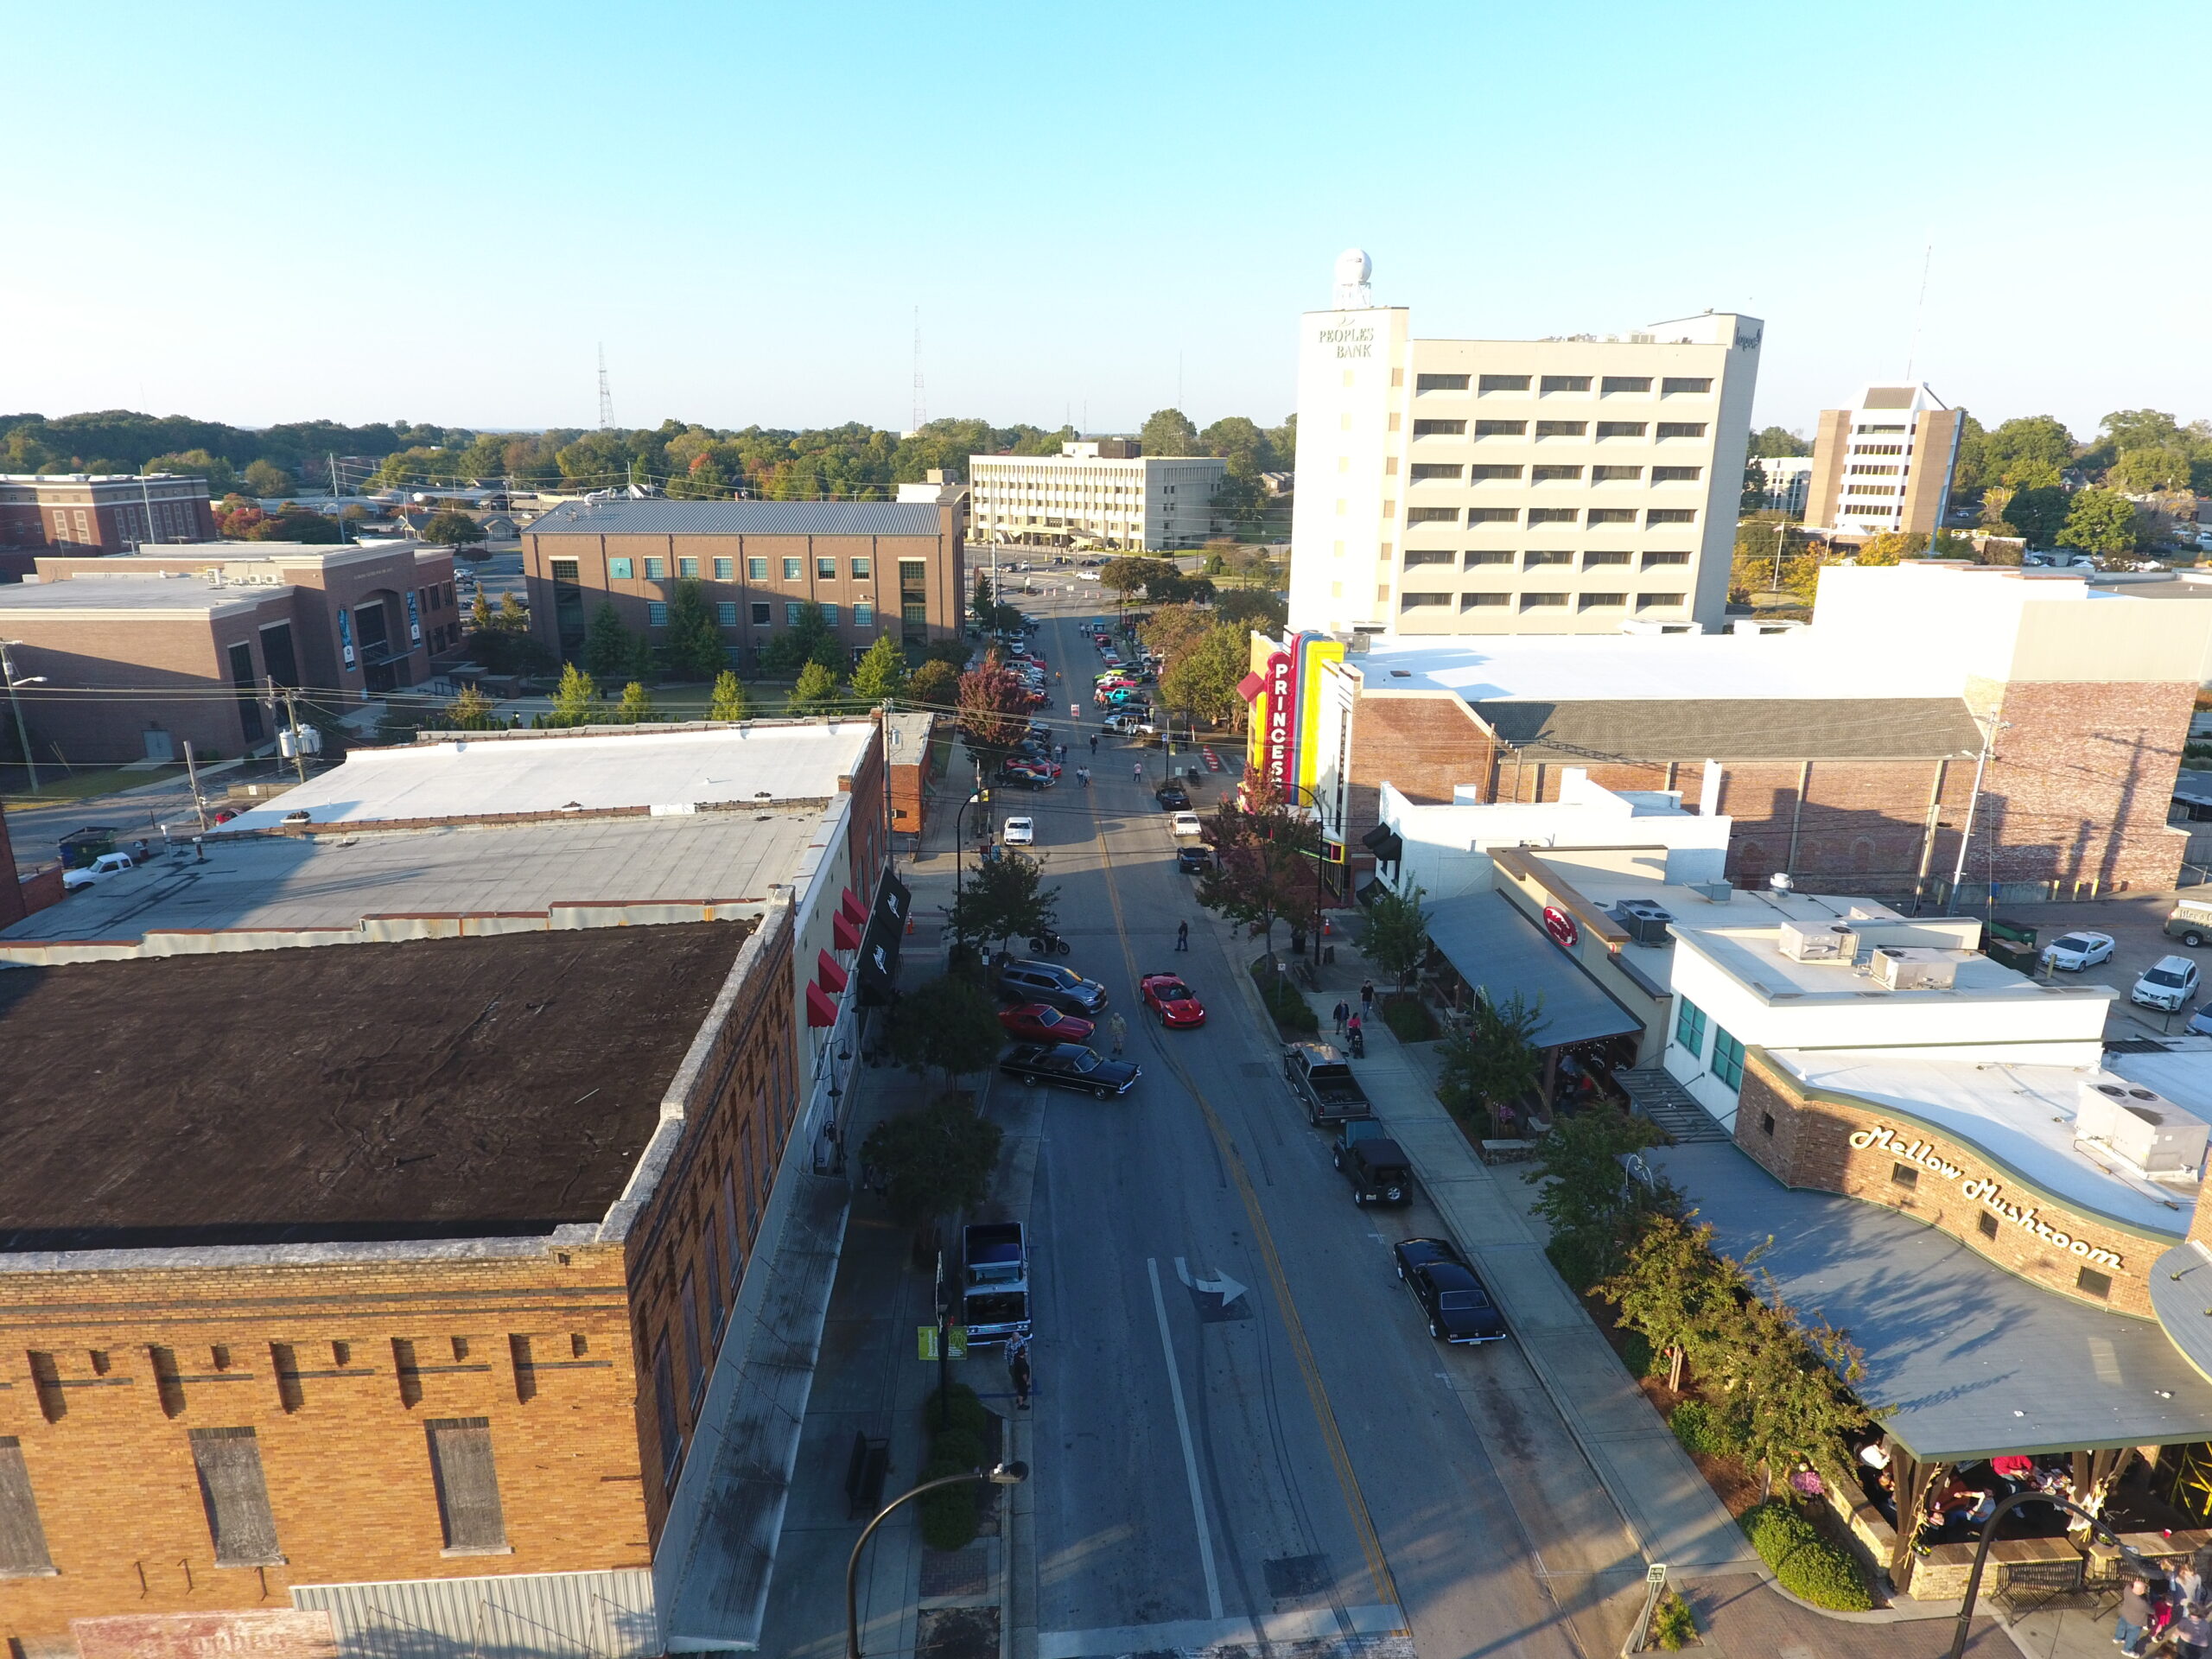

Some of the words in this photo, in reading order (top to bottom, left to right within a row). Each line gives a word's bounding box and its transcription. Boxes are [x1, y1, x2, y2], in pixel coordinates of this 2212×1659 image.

[1337, 344, 1372, 359] BANK
[1849, 1125, 1965, 1180] Mellow
[1962, 1177, 2125, 1270] Mushroom
